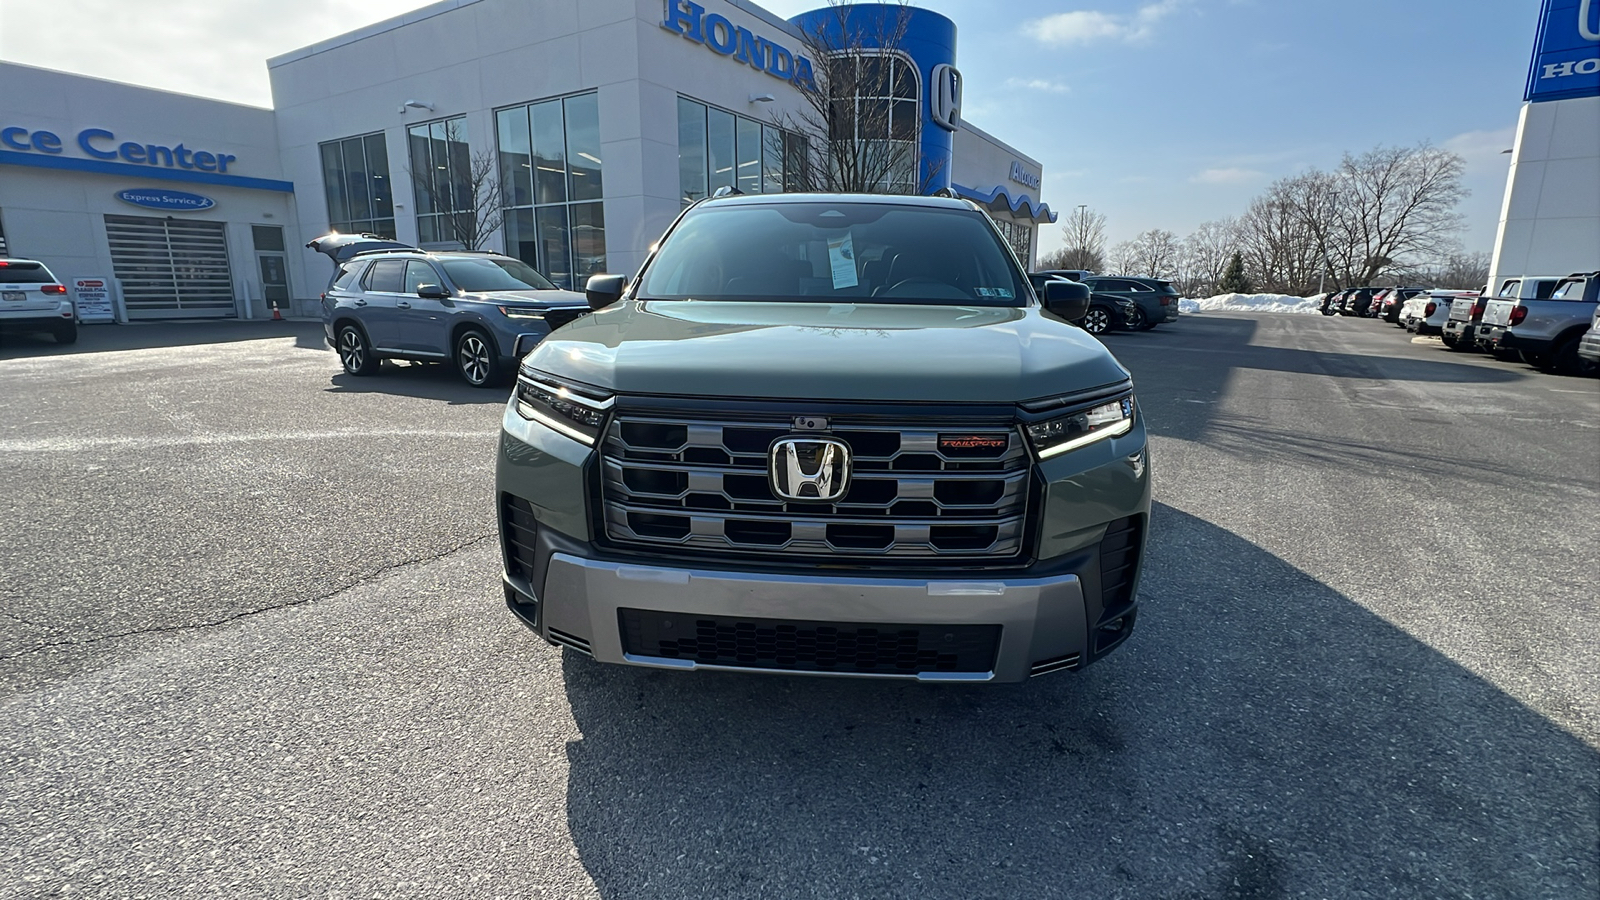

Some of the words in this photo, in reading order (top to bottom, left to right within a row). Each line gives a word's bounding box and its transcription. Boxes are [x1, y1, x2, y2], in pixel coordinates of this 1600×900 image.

[659, 0, 817, 94] HONDA
[77, 128, 236, 173] Center
[123, 192, 160, 202] Express
[162, 195, 197, 205] Service
[941, 440, 1005, 448] TRAILSPORT
